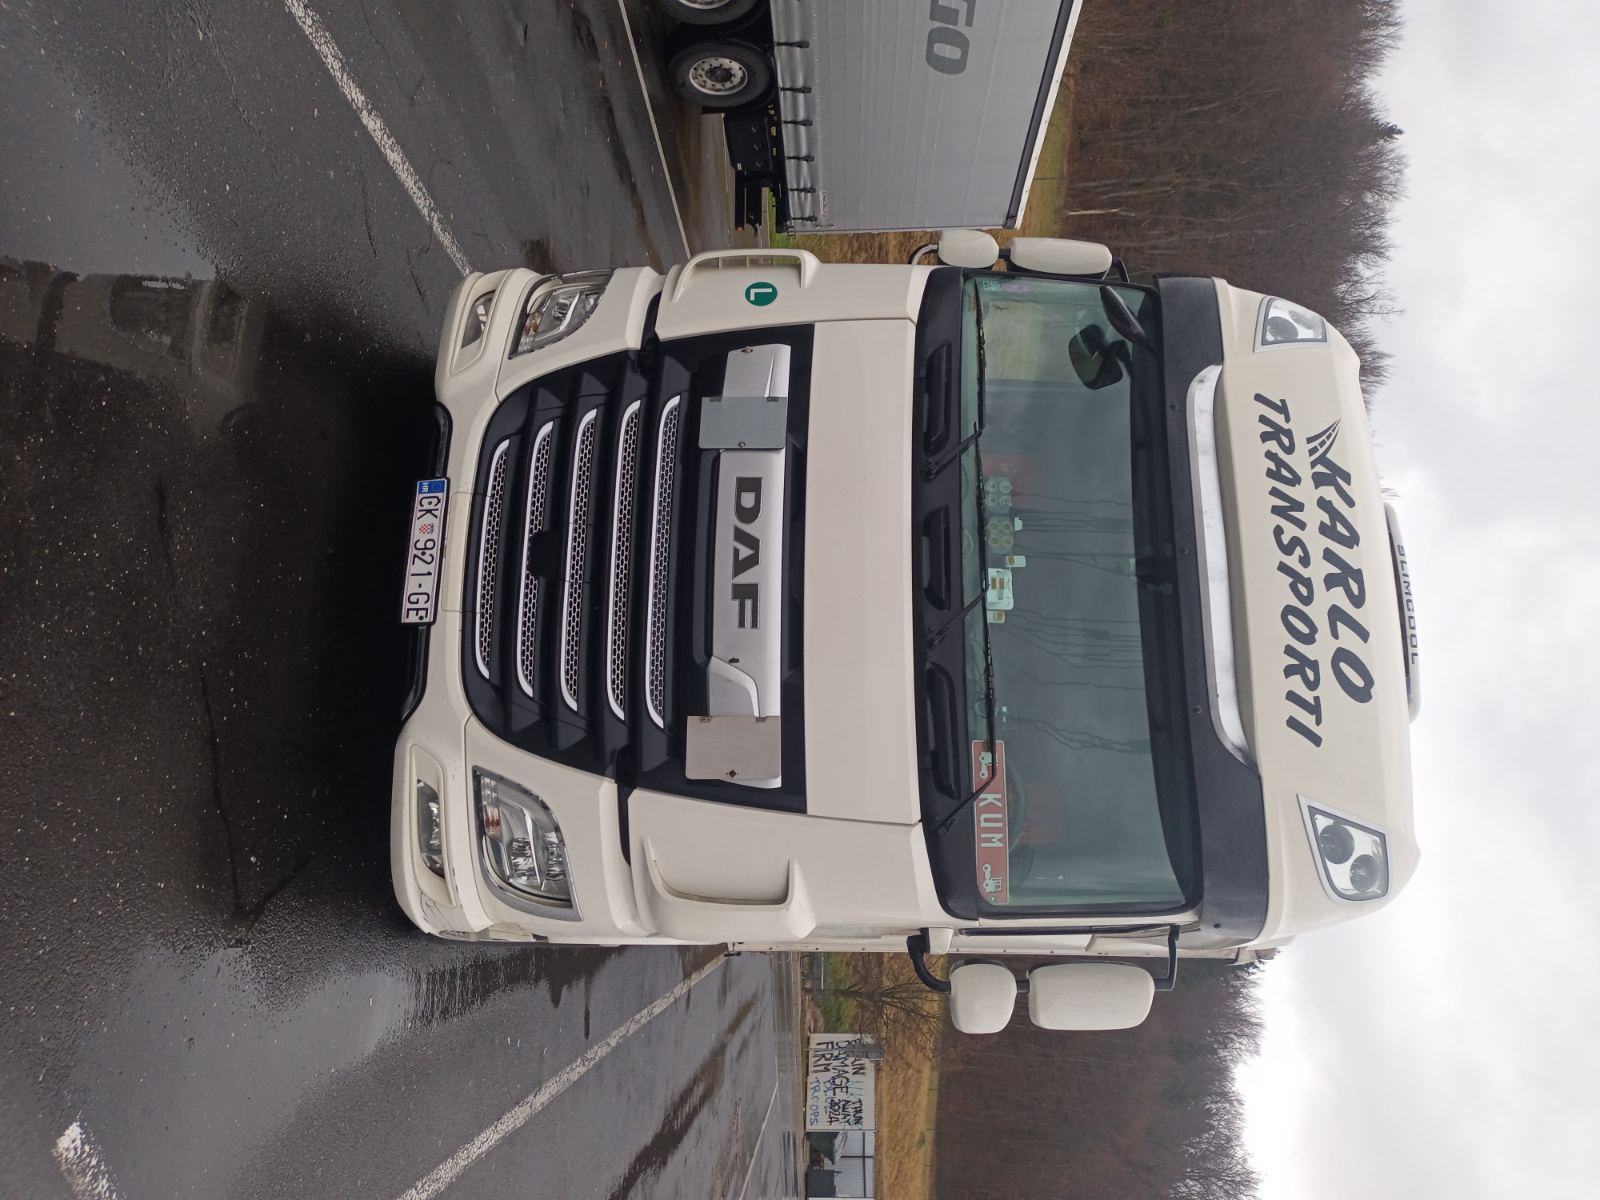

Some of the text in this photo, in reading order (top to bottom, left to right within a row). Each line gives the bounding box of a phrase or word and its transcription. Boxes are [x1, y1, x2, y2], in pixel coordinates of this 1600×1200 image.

[749, 287, 772, 301] L
[421, 482, 429, 493] HR
[731, 475, 764, 630] DAF
[1253, 392, 1322, 748] TRANSPORTI
[1308, 450, 1375, 703] KARLO
[1396, 543, 1418, 665] SLIMCOOL
[978, 793, 1003, 848] KUM
[832, 1040, 850, 1096] DAMAGE
[839, 1099, 852, 1126] AWAY
